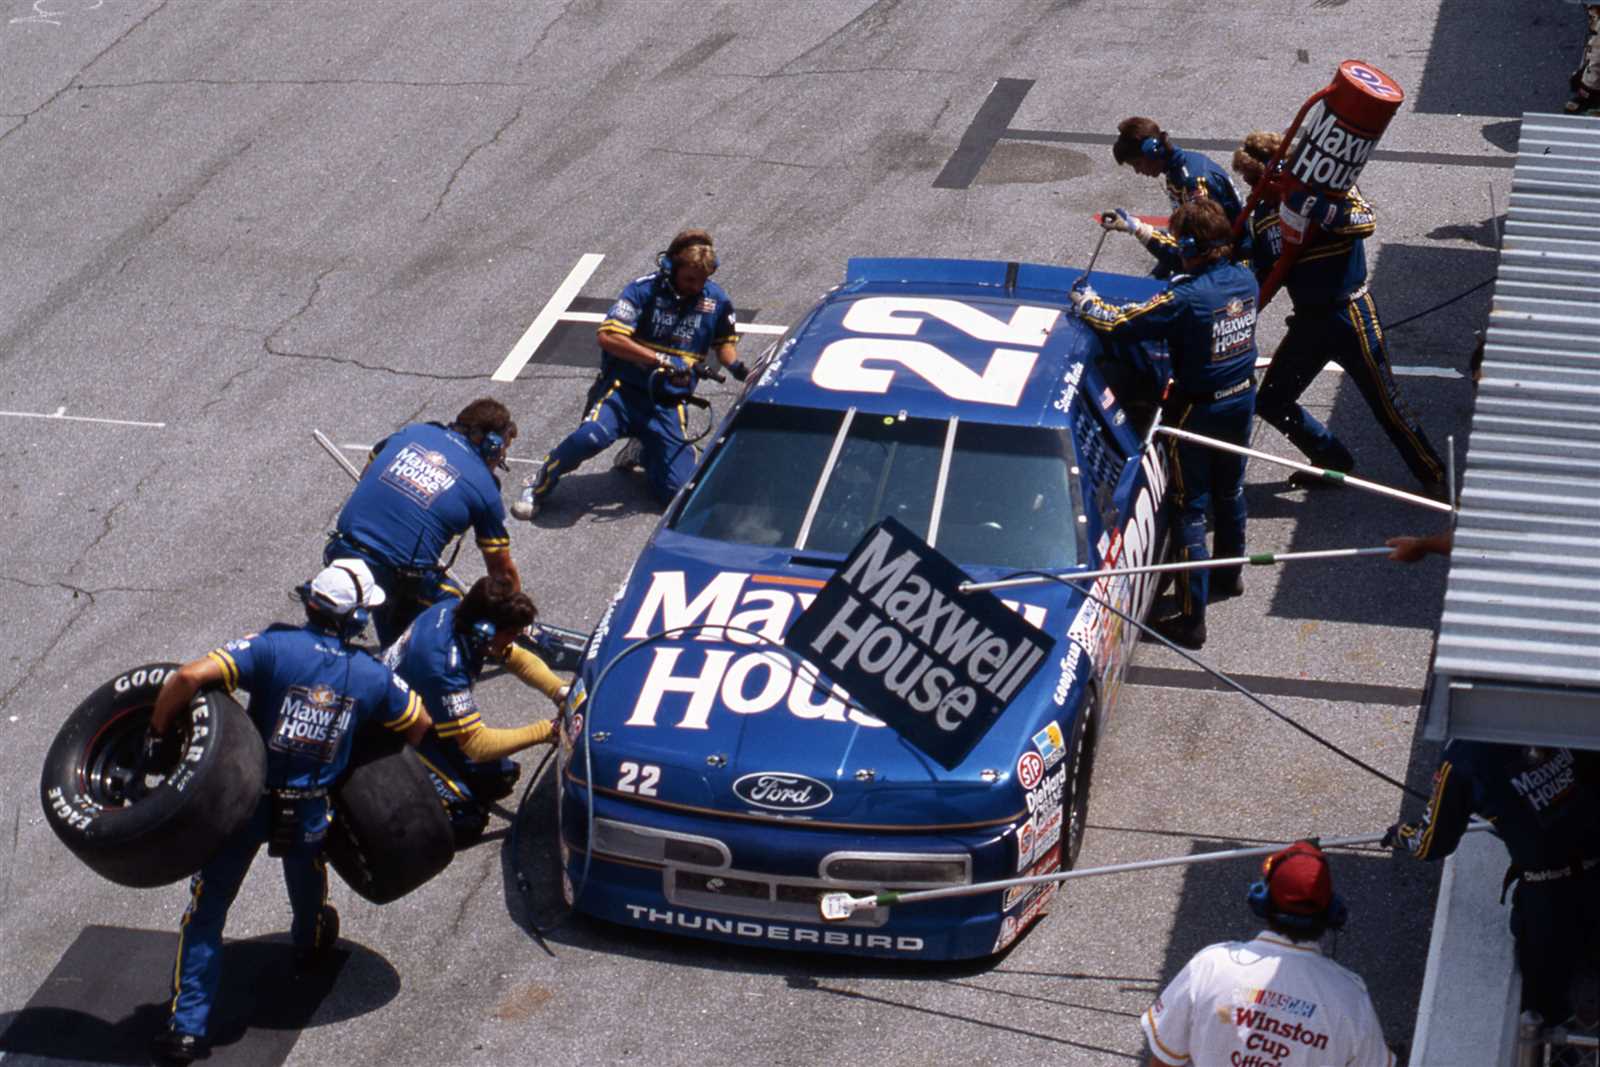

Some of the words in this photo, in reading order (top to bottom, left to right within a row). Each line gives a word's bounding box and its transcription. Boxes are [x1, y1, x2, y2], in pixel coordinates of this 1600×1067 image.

[811, 297, 1062, 407] 22
[1216, 327, 1252, 353] House
[389, 460, 439, 494] House
[395, 447, 456, 491] Maxwell
[841, 527, 1045, 702] Maxwell
[810, 596, 977, 732] House
[617, 762, 661, 797] 22
[750, 775, 813, 804] Ford
[1021, 757, 1040, 785] STP
[1025, 762, 1067, 815] DieHard
[48, 786, 93, 830] EAGLE
[626, 904, 924, 951] THUNDERBIRD
[1235, 1006, 1329, 1050] Winston
[1246, 1032, 1291, 1059] Cup
